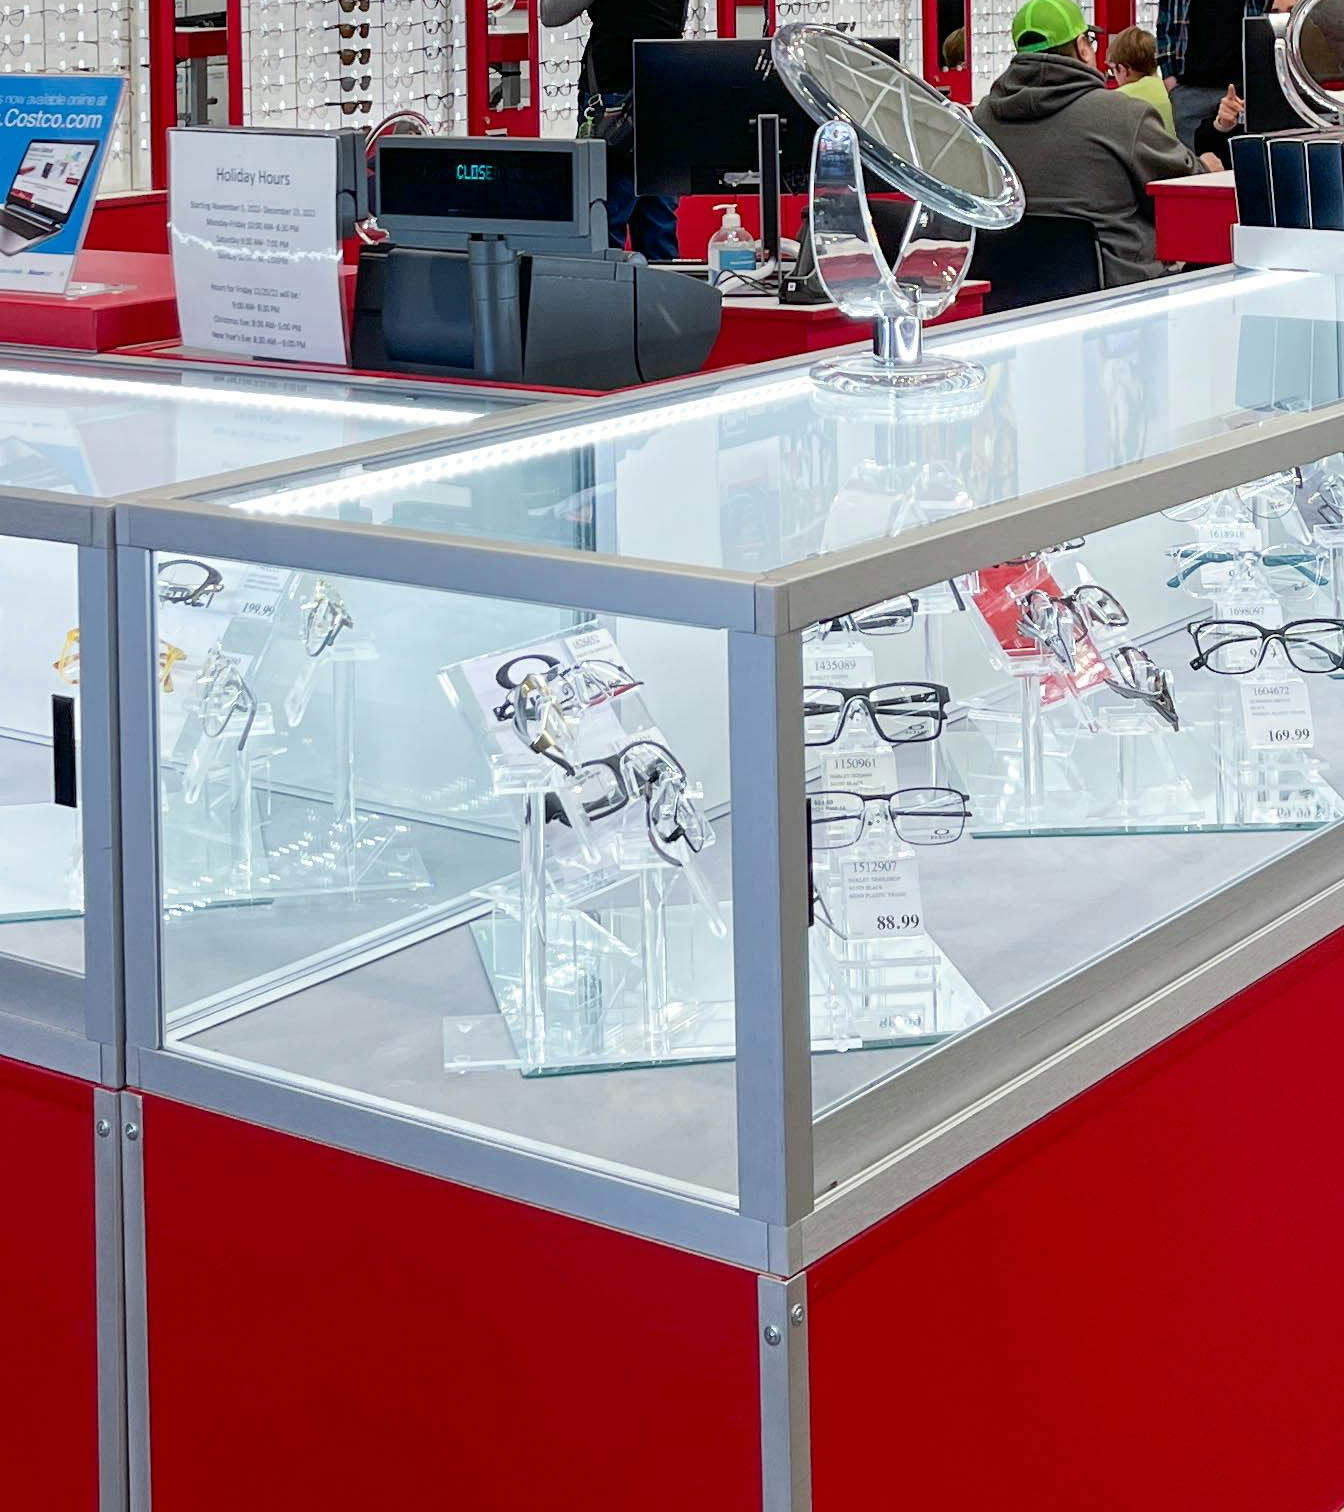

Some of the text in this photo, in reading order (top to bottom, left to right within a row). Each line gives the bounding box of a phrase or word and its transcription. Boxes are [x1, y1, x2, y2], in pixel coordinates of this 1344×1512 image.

[5, 95, 24, 104] now
[26, 93, 66, 105] available
[67, 94, 95, 105] online
[216, 167, 291, 186] Holiday Hours
[457, 164, 497, 180] CLOSE
[241, 601, 276, 617] 199.99
[814, 658, 857, 672] 1435089
[1268, 728, 1310, 742] 169.99
[834, 757, 877, 769] 1150961
[853, 860, 897, 873] 1512907
[876, 913, 920, 931] 88.99
